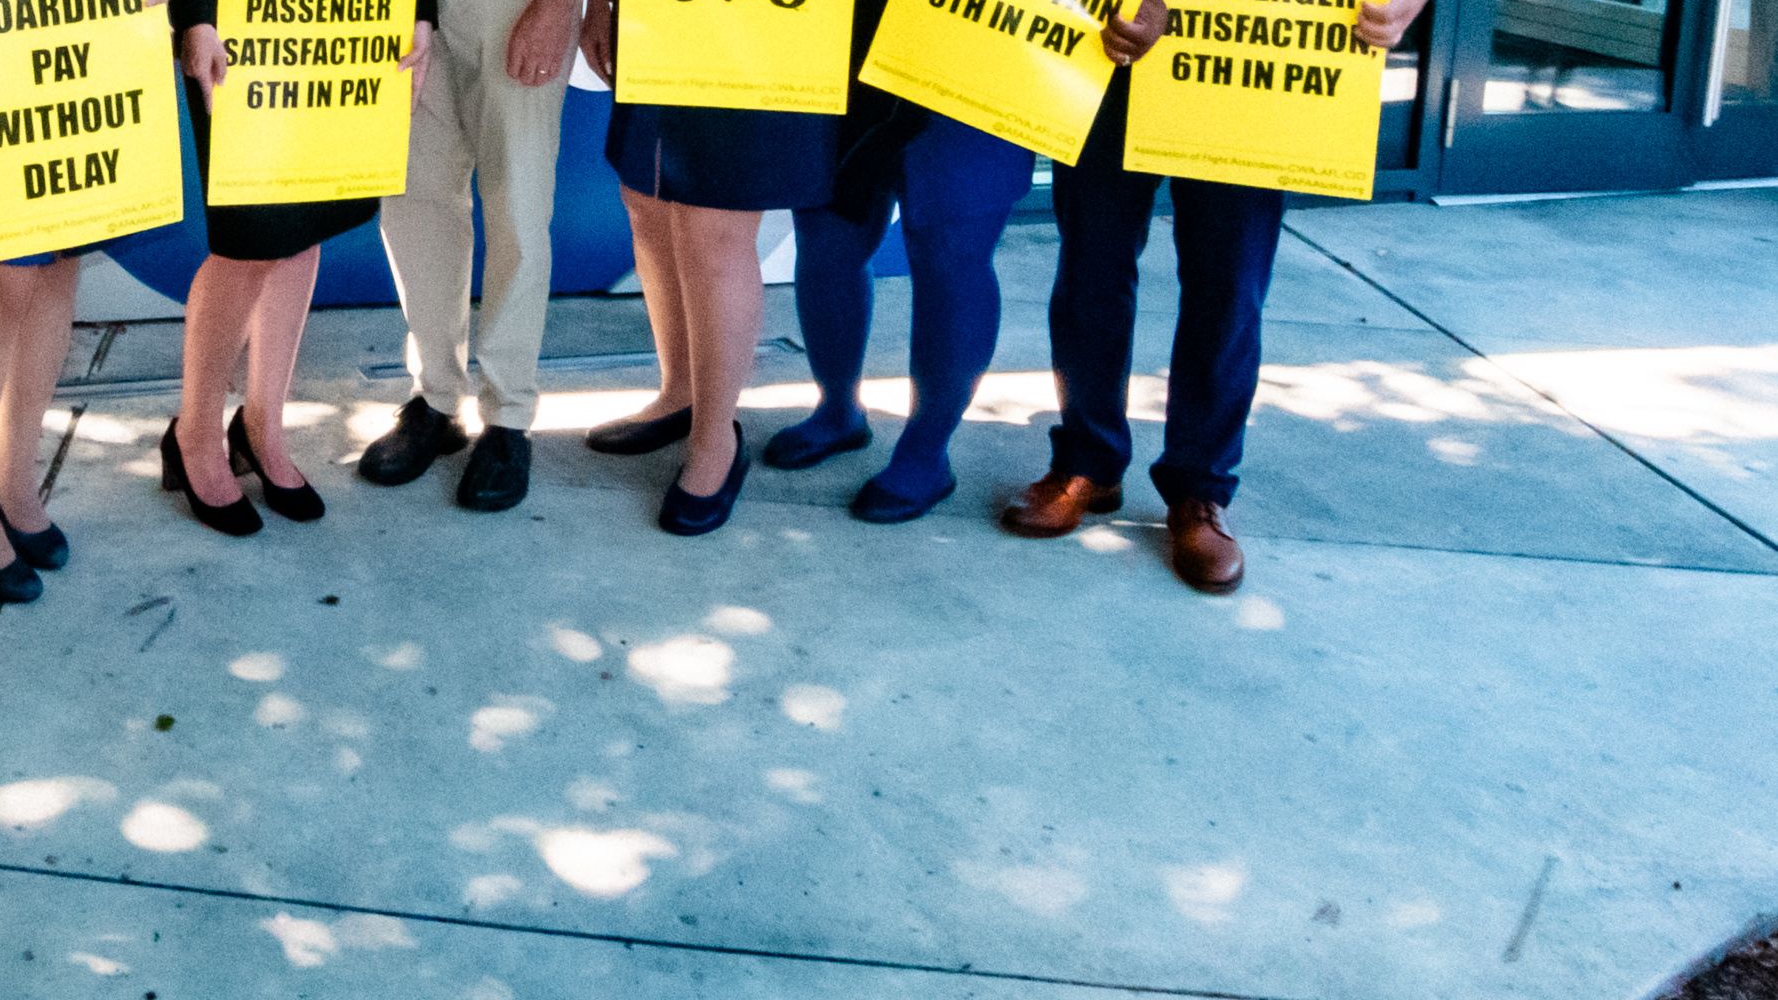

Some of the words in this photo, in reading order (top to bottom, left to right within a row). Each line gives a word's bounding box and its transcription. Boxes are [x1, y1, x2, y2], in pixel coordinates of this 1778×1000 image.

[223, 35, 401, 67] SATISFACTION
[988, 1, 1025, 37] IN
[1025, 13, 1086, 57] PAY
[31, 43, 91, 85] PAY
[1171, 52, 1234, 86] 6TH
[1242, 59, 1275, 91] IN
[1283, 63, 1342, 98] PAY
[247, 80, 299, 109] 6TH
[307, 79, 332, 108] IN
[340, 77, 382, 107] PAY
[23, 149, 120, 200] DELAY
